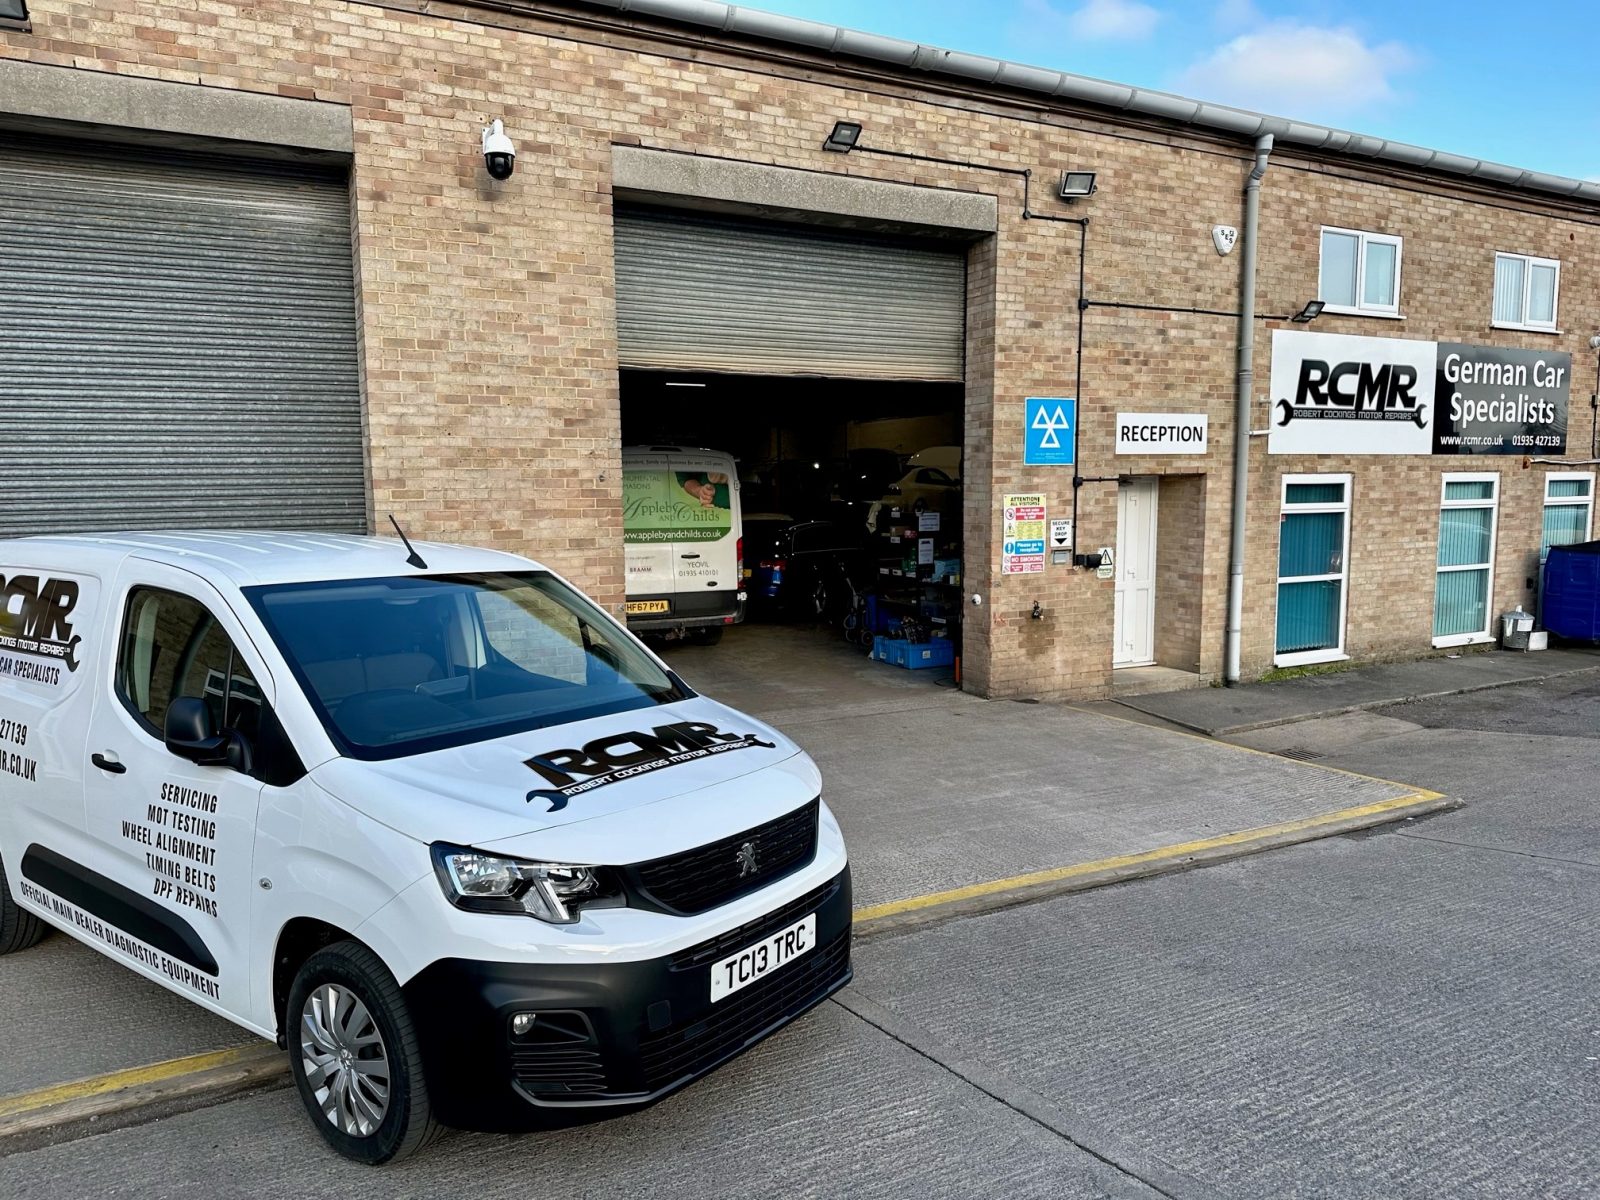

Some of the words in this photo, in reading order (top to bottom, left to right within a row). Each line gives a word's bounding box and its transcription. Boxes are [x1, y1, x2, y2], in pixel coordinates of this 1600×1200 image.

[1295, 358, 1417, 410] RCMR
[1444, 353, 1527, 387] German
[1533, 360, 1565, 389] Car
[1293, 409, 1321, 418] ROBERT
[1323, 410, 1356, 419] COCKINGS
[1358, 411, 1383, 419] MOTOR
[1384, 412, 1412, 420] REPAIRS
[1450, 392, 1555, 428] Specialists
[1120, 425, 1203, 442] RECEPTION
[1440, 435, 1504, 446] www.rcmr.co.uk
[1512, 435, 1534, 446] 01935
[1535, 436, 1560, 446] 427139
[674, 501, 720, 522] Childs
[0, 573, 79, 643] CMR
[626, 603, 647, 611] HF67
[649, 602, 665, 610] PYA
[0, 636, 17, 647] KINGS
[17, 639, 39, 651] MOTOR
[39, 643, 64, 656] REPAIRS
[0, 656, 12, 674] CAR
[14, 660, 60, 685] SPECIALISTS
[521, 721, 744, 788] RCMR
[562, 775, 613, 796] ROBERT
[614, 759, 670, 779] COCKINGS
[668, 749, 710, 763] MOTOR
[708, 741, 749, 753] REPAIRS
[160, 782, 218, 814] SERVICING
[147, 804, 169, 826] MOT
[172, 811, 216, 840] TESTING
[122, 820, 152, 846] WHEEL
[156, 832, 216, 866] ALIGNMENT
[146, 852, 181, 880] TIMING
[185, 866, 216, 892] BELTS
[153, 877, 173, 899] DPF
[175, 886, 217, 918] REPAIRS
[20, 881, 52, 910] OFFICIAL
[52, 898, 73, 922] MAIN
[74, 910, 104, 940] DEALER
[105, 927, 159, 970] DIAGNOSTIC
[161, 956, 220, 1001] EQUIPMENT
[725, 945, 768, 989] TC13
[774, 924, 806, 964] TRC
